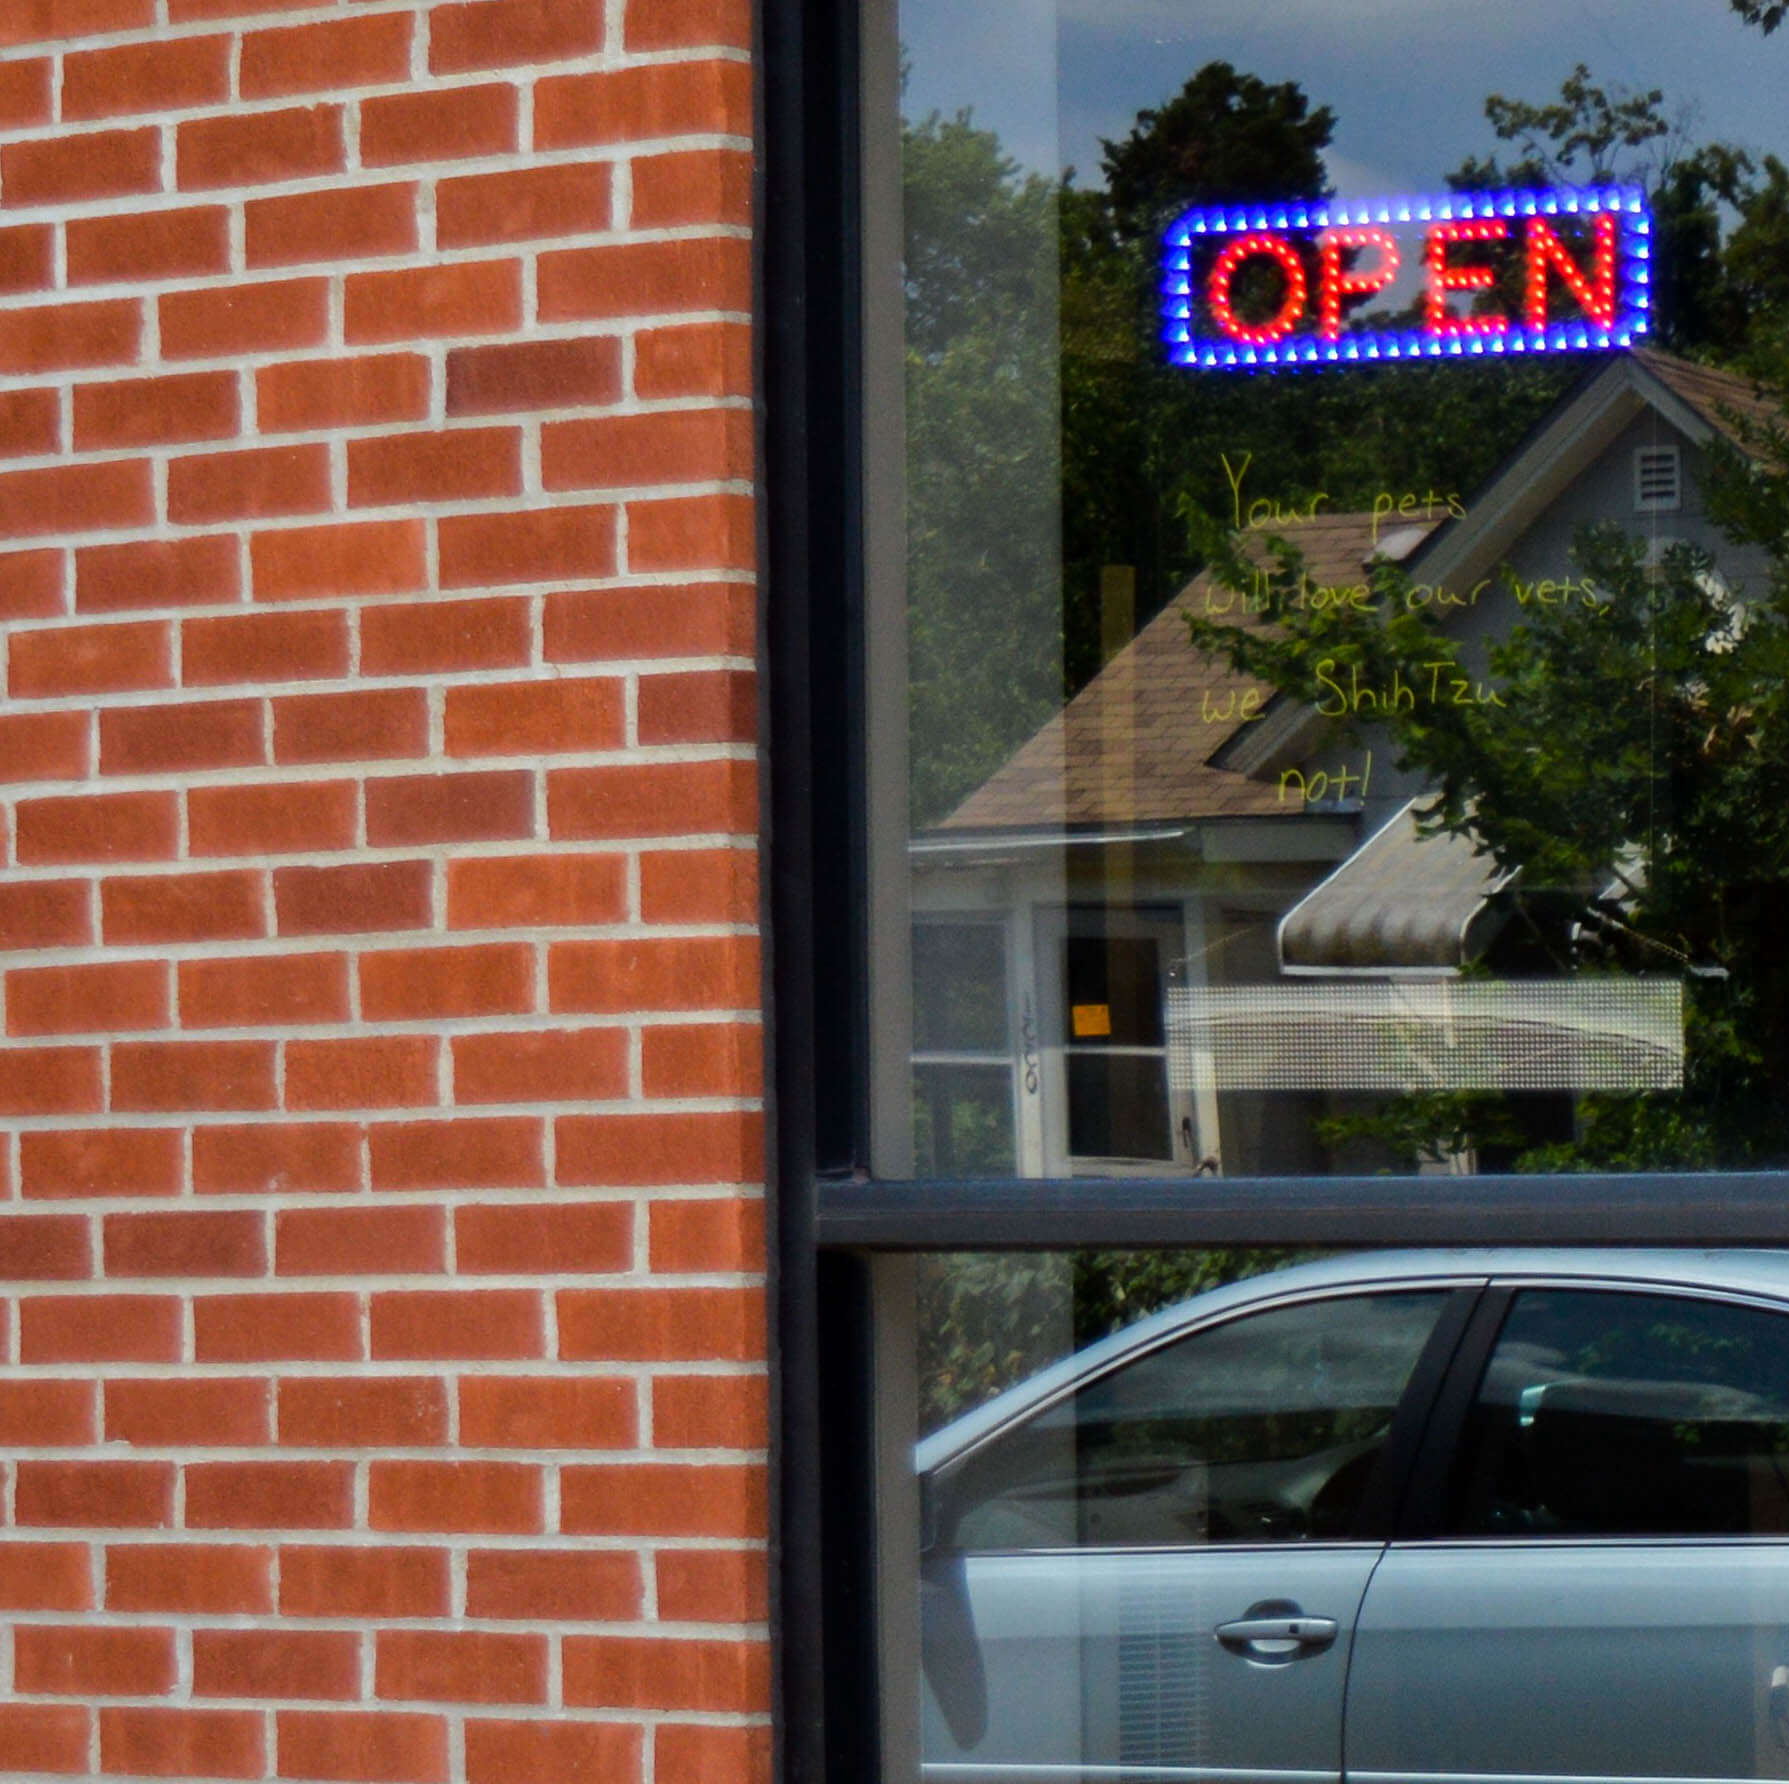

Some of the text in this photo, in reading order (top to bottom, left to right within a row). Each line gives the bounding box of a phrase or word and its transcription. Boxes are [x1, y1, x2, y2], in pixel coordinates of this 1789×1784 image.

[1210, 214, 1615, 344] OPEN
[1221, 453, 1467, 544] Your pets
[1206, 580, 1270, 614] will
[1299, 568, 1379, 612] love
[1405, 579, 1492, 610] our
[1201, 687, 1265, 724] we
[1277, 749, 1373, 807] not!
